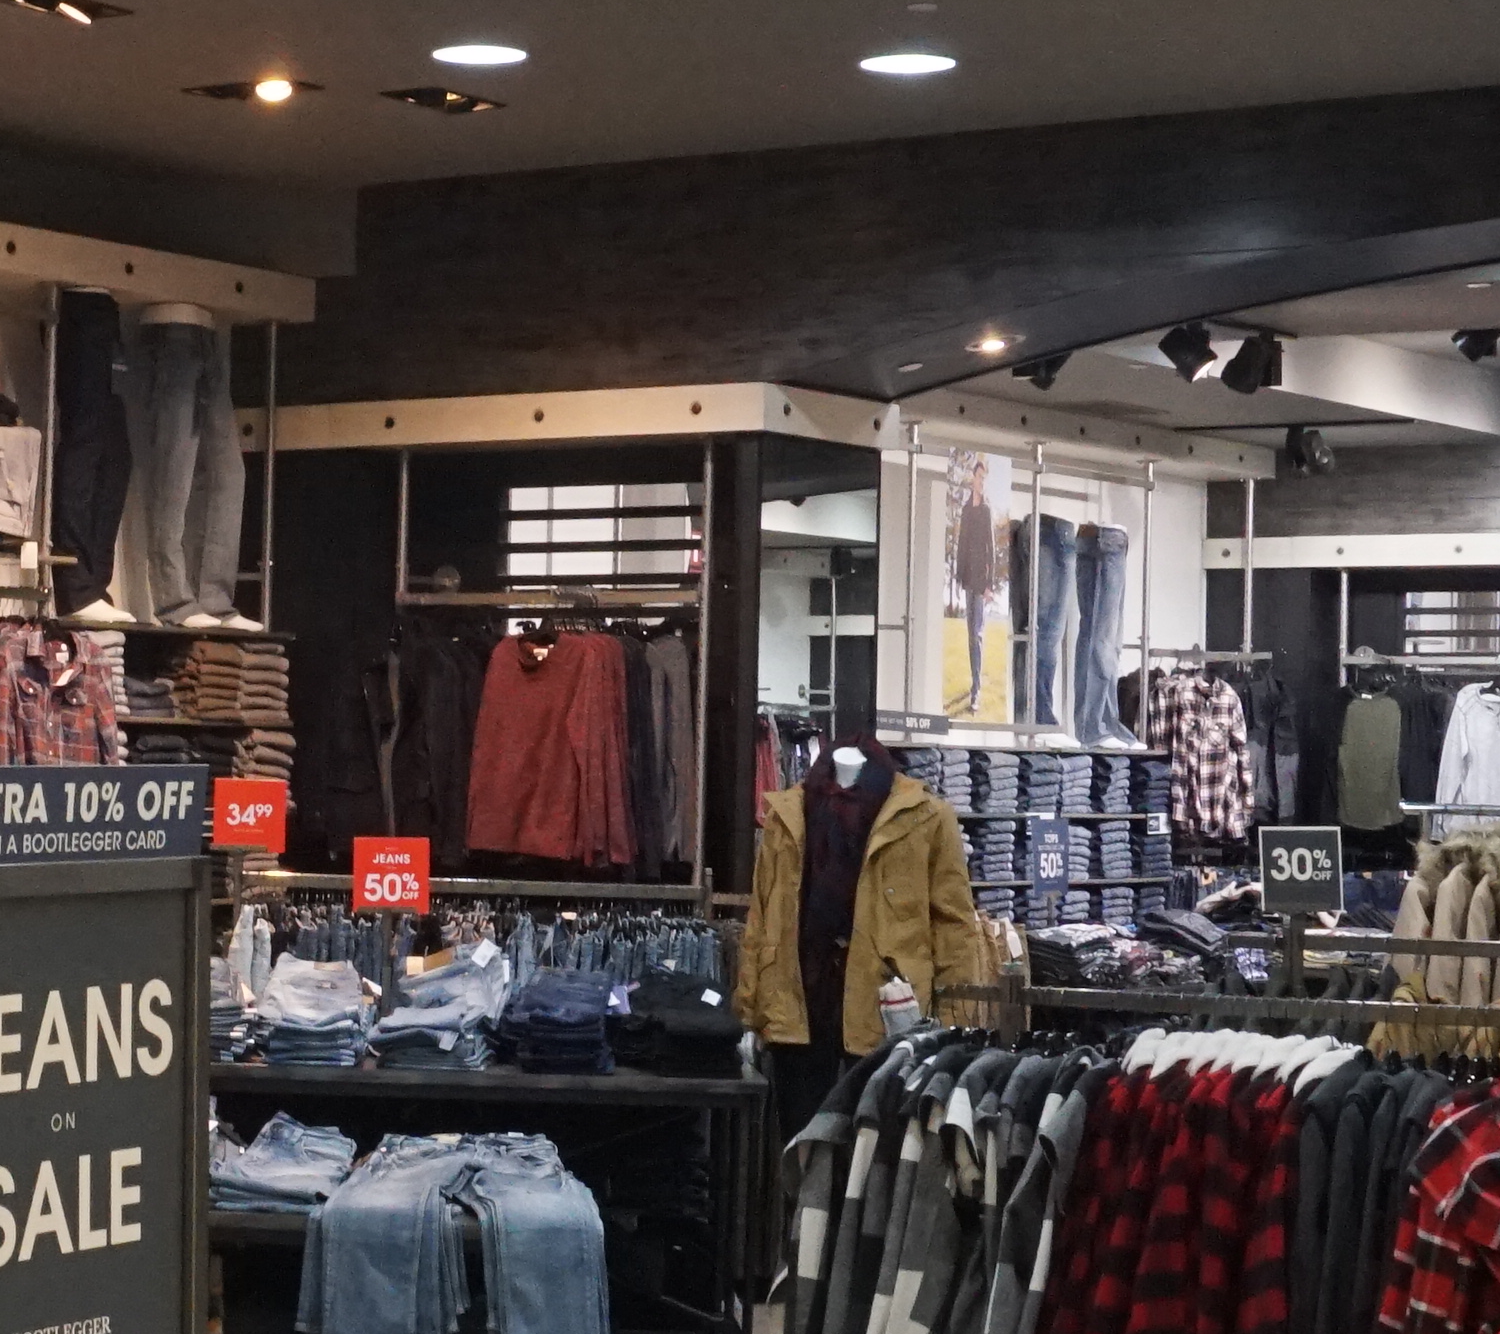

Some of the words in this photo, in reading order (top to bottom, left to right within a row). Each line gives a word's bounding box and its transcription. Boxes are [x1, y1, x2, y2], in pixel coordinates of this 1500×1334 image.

[64, 782, 125, 823] 10%
[137, 781, 195, 821] OFF
[6, 835, 18, 855] A
[23, 831, 121, 854] BOOTLEGGER
[126, 830, 166, 851] CARD
[372, 853, 411, 864] JEANS
[1270, 847, 1332, 881] 30%
[1312, 870, 1333, 881] OFF
[363, 873, 420, 902] 50%
[402, 891, 419, 900] OFF
[51, 1112, 76, 1134] ON
